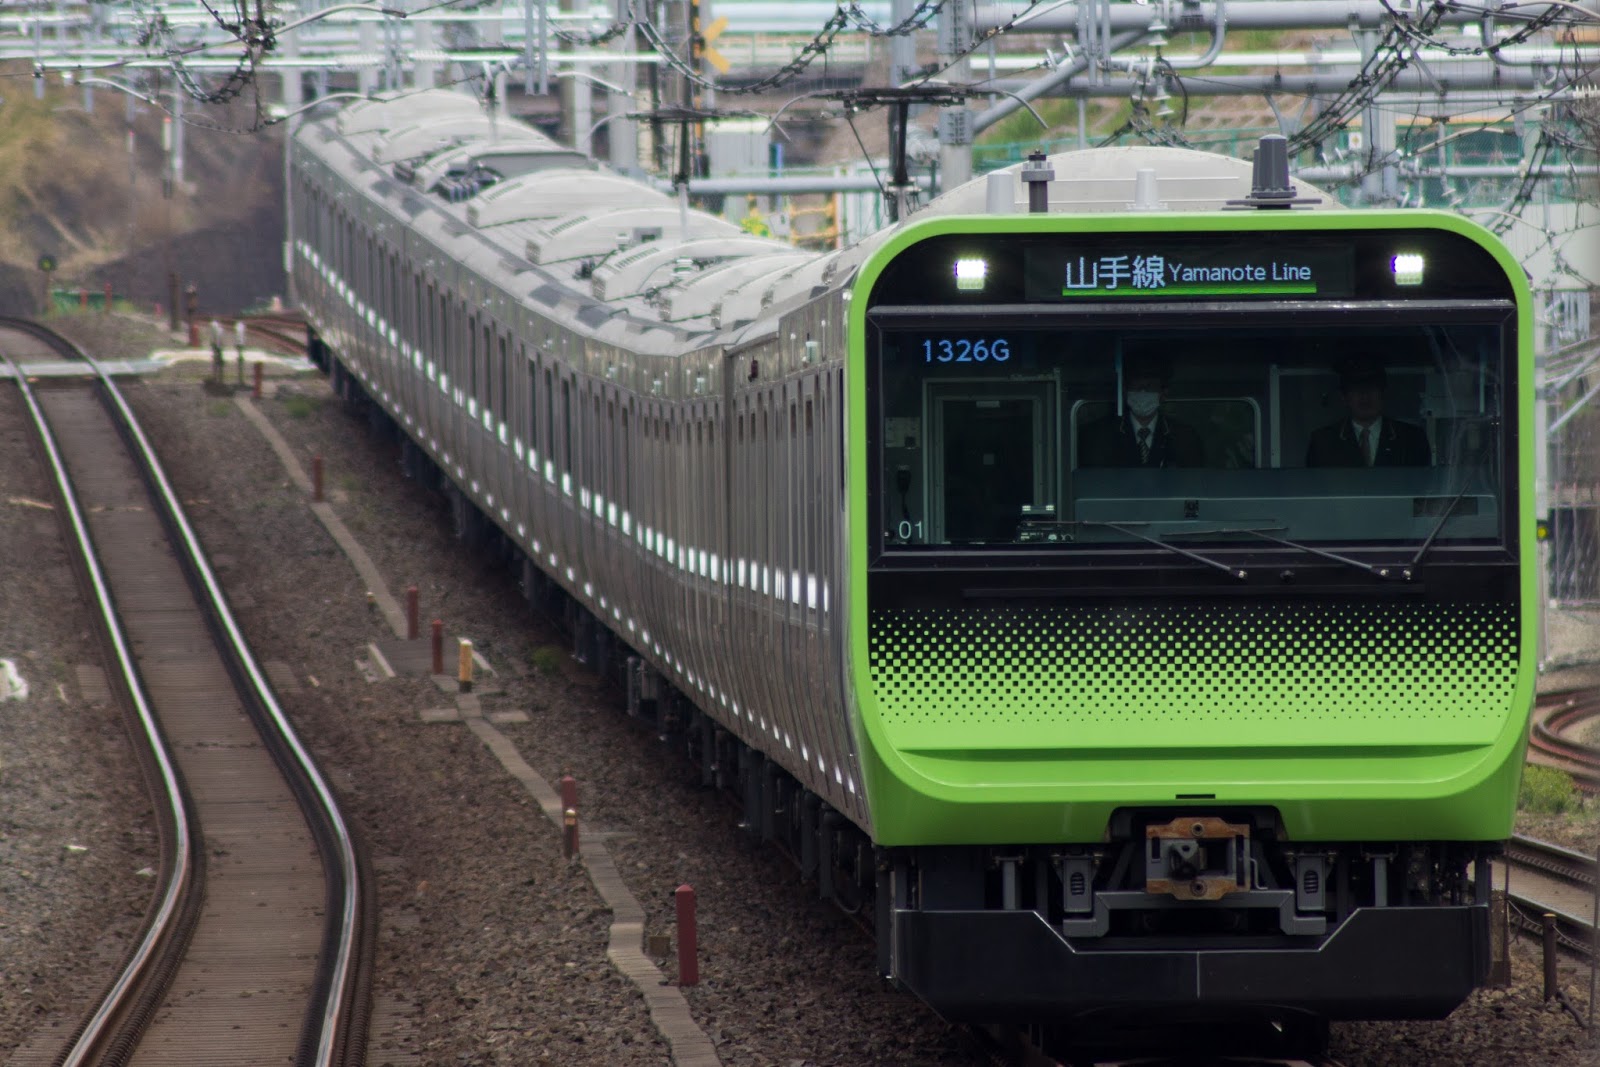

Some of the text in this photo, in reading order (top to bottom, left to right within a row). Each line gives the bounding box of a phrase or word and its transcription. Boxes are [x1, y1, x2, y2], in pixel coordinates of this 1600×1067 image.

[1066, 255, 1166, 289] 山手線
[1168, 262, 1311, 281] Yamanote Line
[923, 339, 1010, 362] 1326G
[898, 521, 923, 539] 01
